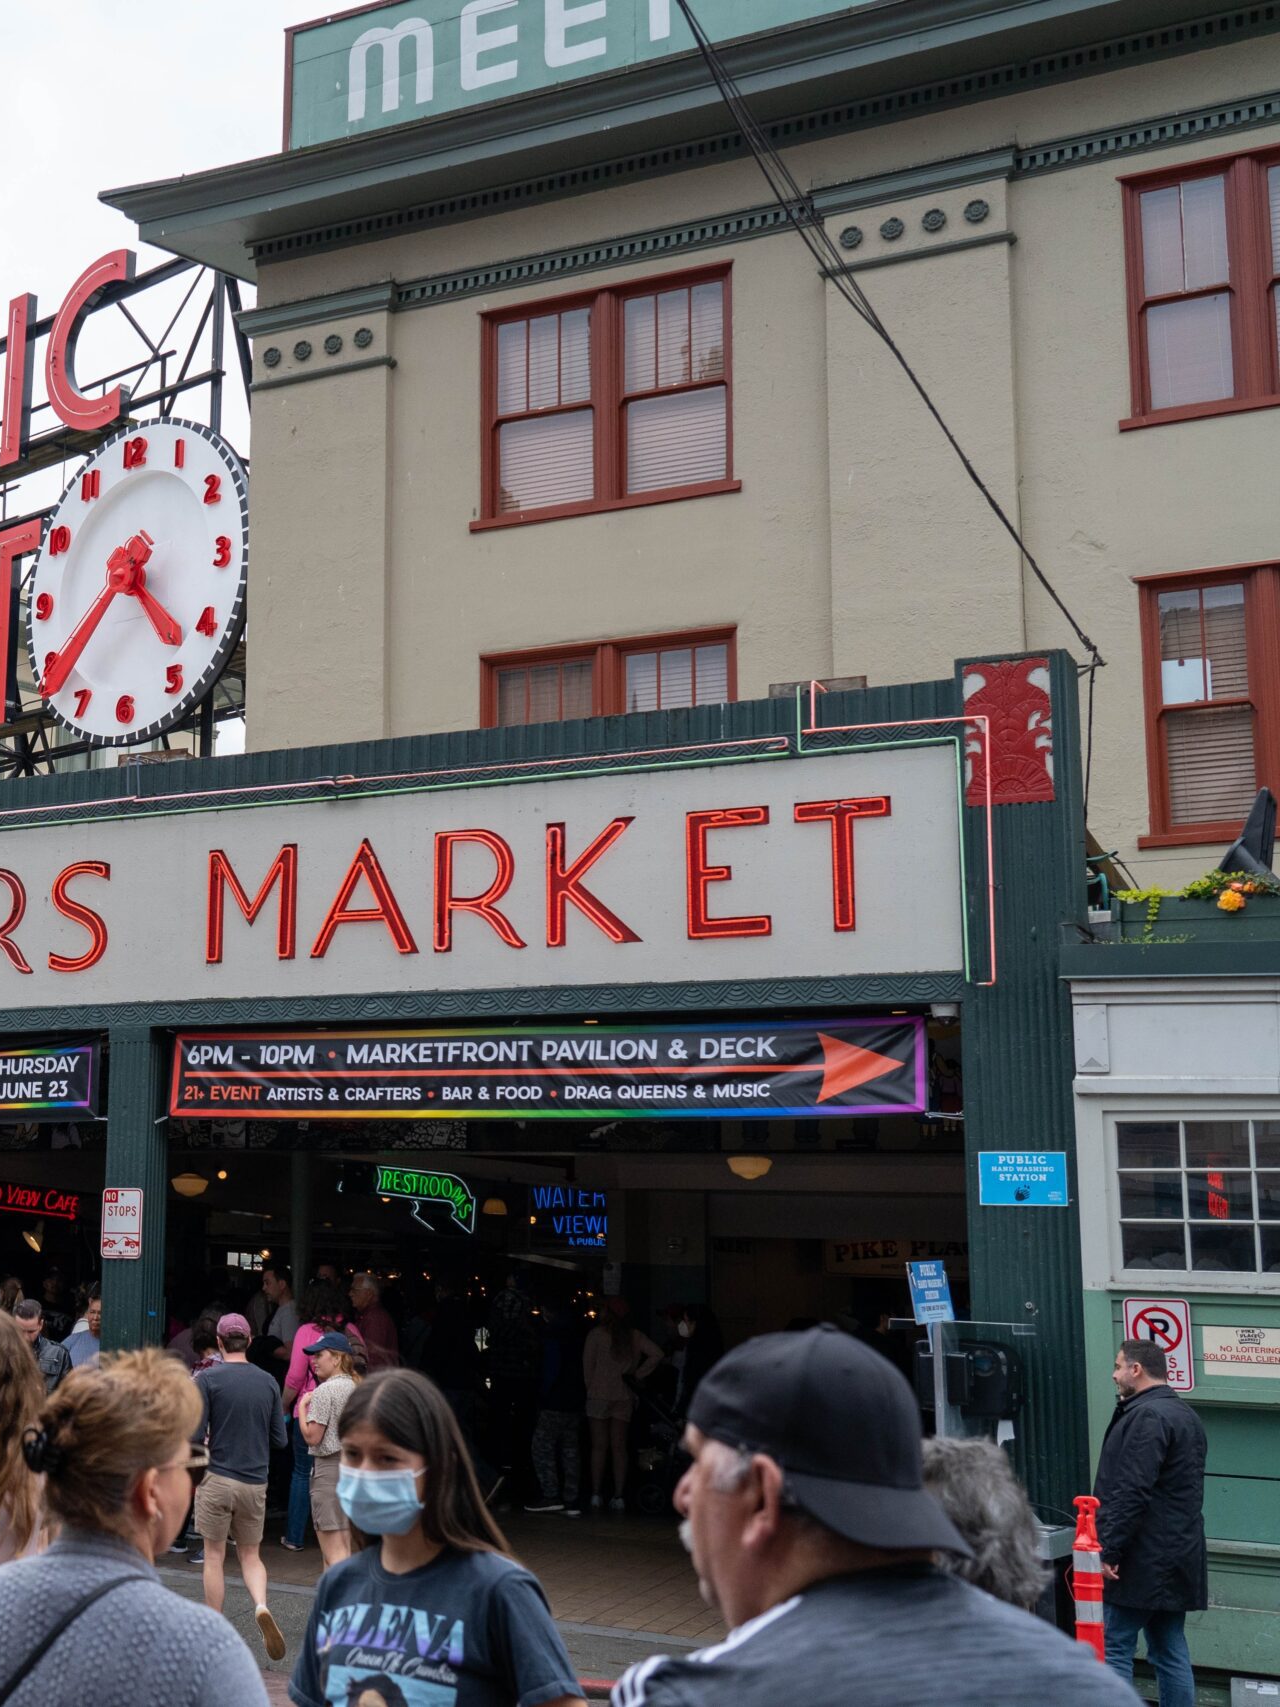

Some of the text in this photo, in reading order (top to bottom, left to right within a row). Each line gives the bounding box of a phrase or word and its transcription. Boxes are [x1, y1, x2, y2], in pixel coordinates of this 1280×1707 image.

[123, 436, 148, 469] 12
[175, 439, 185, 468] 1
[81, 470, 100, 501] 11
[203, 474, 221, 504] 2
[49, 526, 71, 556] 10
[213, 536, 231, 568] 3
[36, 592, 53, 621] 9
[195, 607, 218, 637] 4
[165, 664, 183, 695] 5
[74, 689, 92, 718] 7
[116, 695, 134, 724] 6
[206, 796, 891, 964] MARKET
[187, 1045, 233, 1065] 6PM
[259, 1045, 315, 1065] 10PM
[346, 1040, 534, 1065] MARKETFRONT
[541, 1038, 658, 1061] PAVILION
[667, 1037, 689, 1060] &
[699, 1037, 777, 1060] DECK
[48, 1080, 68, 1098] 23
[184, 1083, 770, 1102] 21+ EVENT ARTISTS & CRAFTERS BAR & FOOD DRAG QUEENS & MUSIC
[998, 1155, 1047, 1164] PUBLIC
[999, 1174, 1047, 1182] STATION
[7, 1184, 41, 1207] VIEW
[45, 1190, 79, 1212] CAFE
[105, 1192, 117, 1201] NO
[381, 1170, 472, 1219] RESTROOMS
[108, 1205, 137, 1217] STOPS
[833, 1240, 898, 1262] PIKE
[1231, 1354, 1252, 1362] PARA
[1236, 1346, 1280, 1354] LOITERING
[316, 1602, 465, 1666] SELENA
